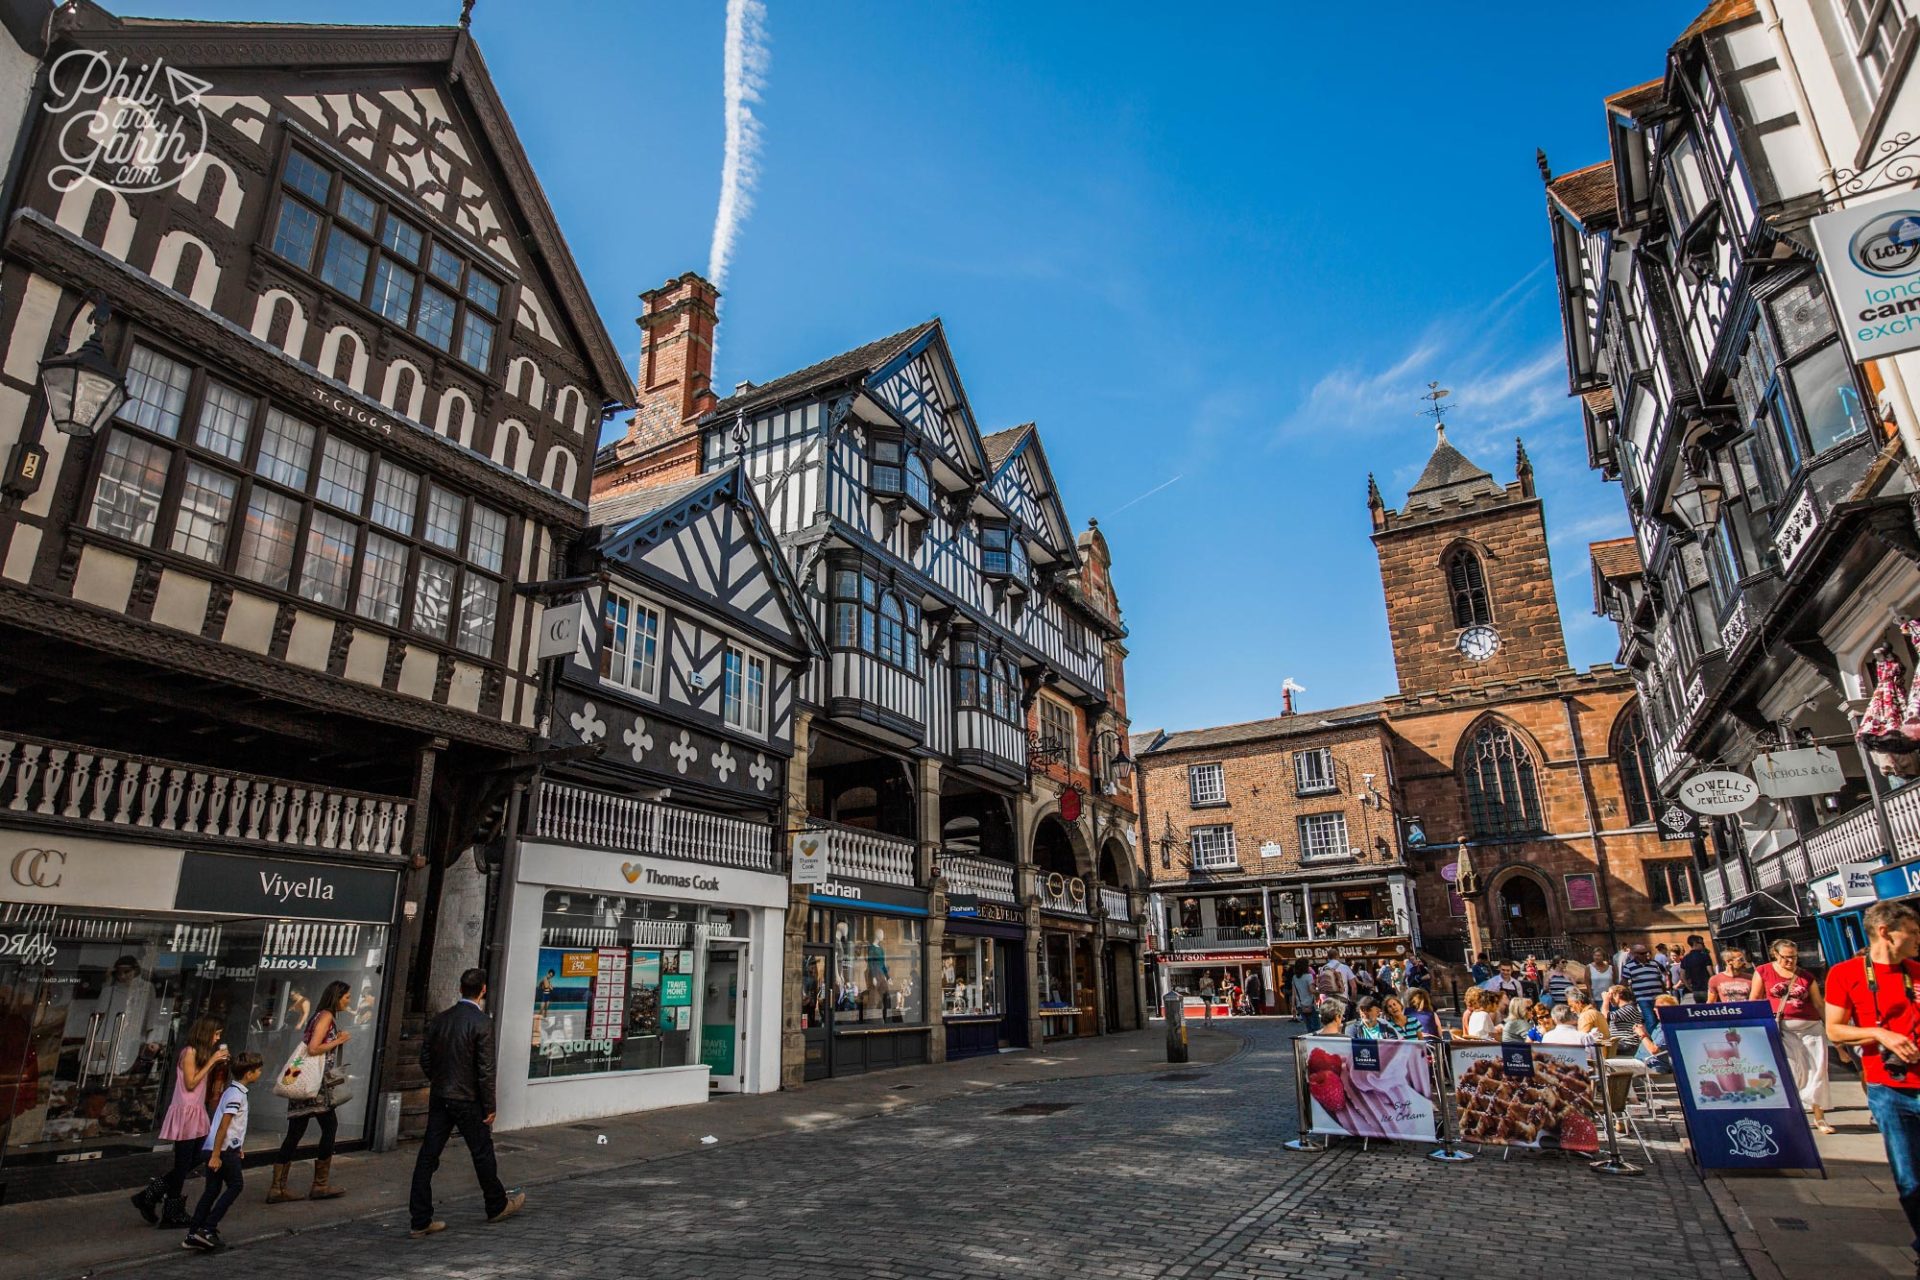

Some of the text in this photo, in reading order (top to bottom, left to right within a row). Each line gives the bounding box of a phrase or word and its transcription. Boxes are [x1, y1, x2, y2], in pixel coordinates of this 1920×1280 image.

[1873, 244, 1907, 260] LCE
[1858, 314, 1920, 341] exch
[1811, 766, 1819, 775] &
[1821, 764, 1838, 774] Co.
[1686, 779, 1752, 798] POWELLS
[1696, 794, 1745, 805] JEWELLERS
[1665, 831, 1696, 840] SHOES
[10, 848, 67, 888] CC
[645, 868, 720, 891] Thomas Cook
[1850, 872, 1870, 881] Hay
[259, 871, 335, 902] Viyella
[813, 879, 861, 900] Rohan
[1848, 880, 1873, 889] Trav
[996, 905, 1025, 922] EVELYN
[1166, 953, 1206, 962] TIMPSON
[1294, 946, 1363, 959] OLD GUY RULE
[667, 980, 687, 988] TRAVEL
[1686, 1006, 1743, 1018] Leonidas
[563, 1038, 613, 1056] daring
[1460, 1050, 1492, 1060] Belgian
[1394, 1100, 1412, 1111] Soft
[1381, 1111, 1427, 1122] Ice Cream
